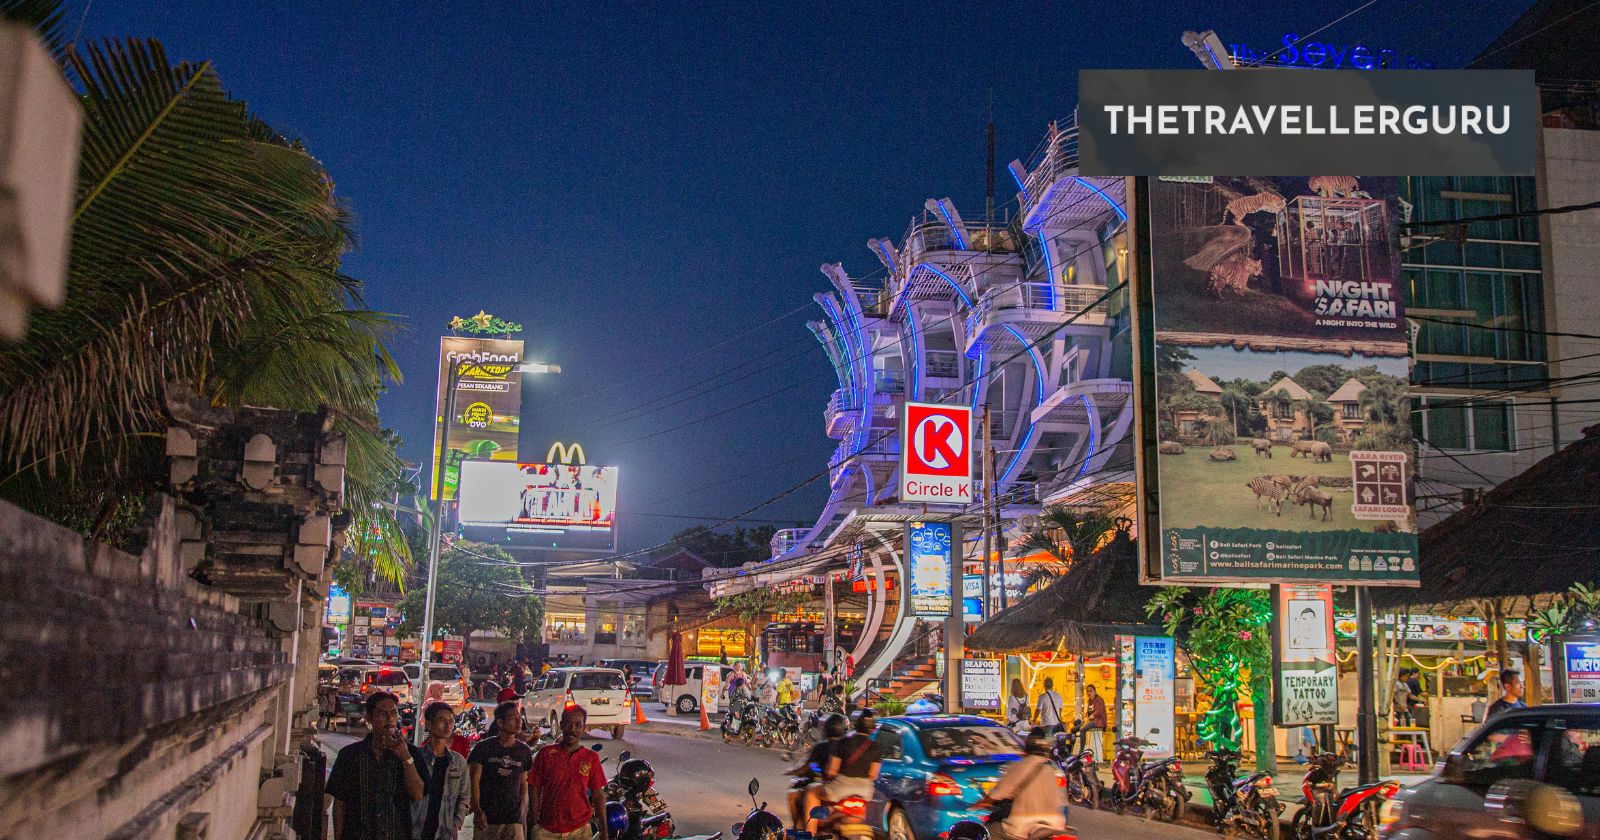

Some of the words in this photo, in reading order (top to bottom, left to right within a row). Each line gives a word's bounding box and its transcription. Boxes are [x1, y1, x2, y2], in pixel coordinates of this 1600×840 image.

[1279, 32, 1397, 69] Seven
[1316, 279, 1392, 300] NIGHT
[1315, 297, 1396, 319] SAFARI
[1346, 320, 1364, 328] INTO
[1378, 321, 1397, 329] WILD
[1352, 452, 1378, 460] MARA
[1380, 453, 1404, 461] RIVER
[906, 481, 953, 497] Circle
[958, 483, 969, 497] K
[1354, 505, 1380, 513] SAFARI
[1210, 560, 1343, 571] www.balisafarimarinepark.com
[964, 581, 980, 590] VISA
[964, 660, 999, 668] SEAFOOD
[1571, 659, 1592, 672] MONEY
[1285, 676, 1334, 688] TEMPORARY
[1293, 688, 1327, 700] TATTOO
[1584, 688, 1596, 698] USD
